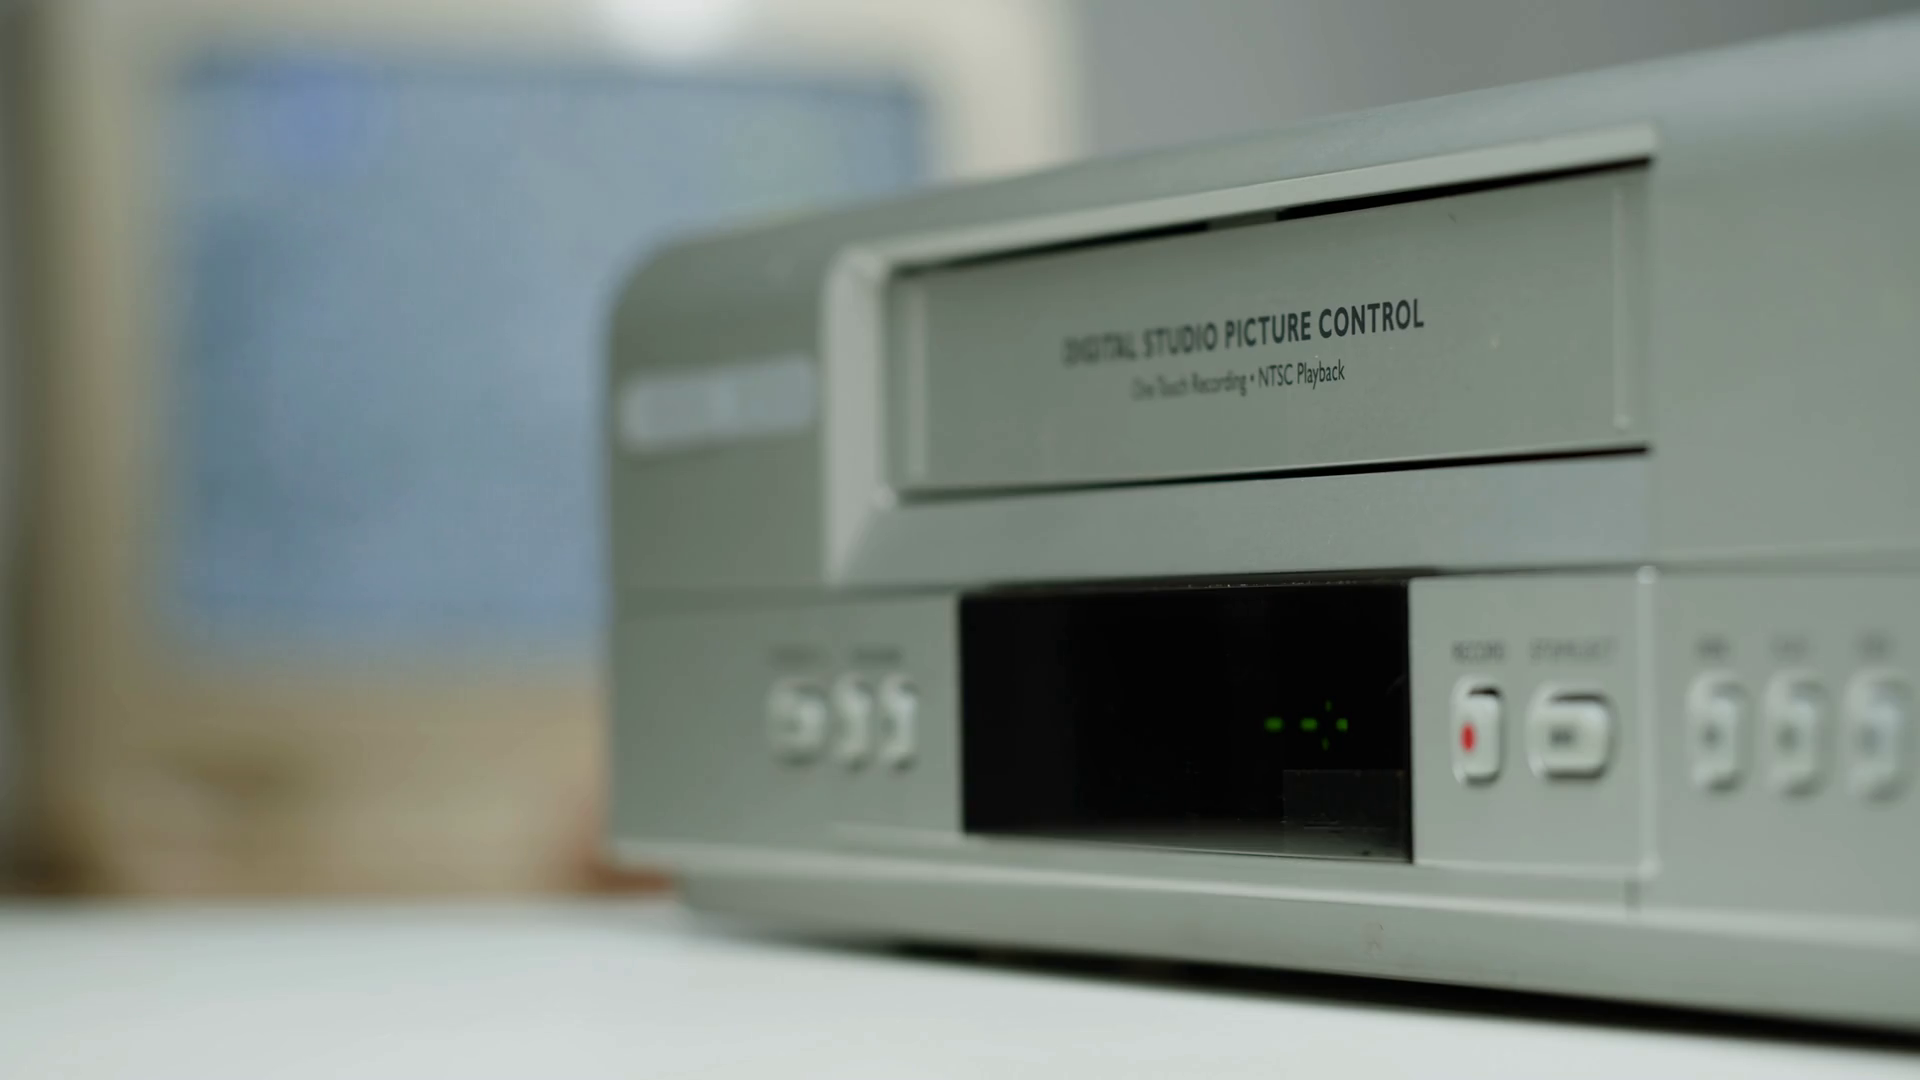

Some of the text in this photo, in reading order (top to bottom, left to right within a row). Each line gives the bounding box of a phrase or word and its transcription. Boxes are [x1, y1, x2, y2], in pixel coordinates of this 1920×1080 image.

[1063, 298, 1425, 366] DIGITAL STUDIO PICTURE CONTROL
[1191, 366, 1247, 397] Recording
[1258, 362, 1293, 388] NTSC
[1297, 358, 1345, 390] Playback
